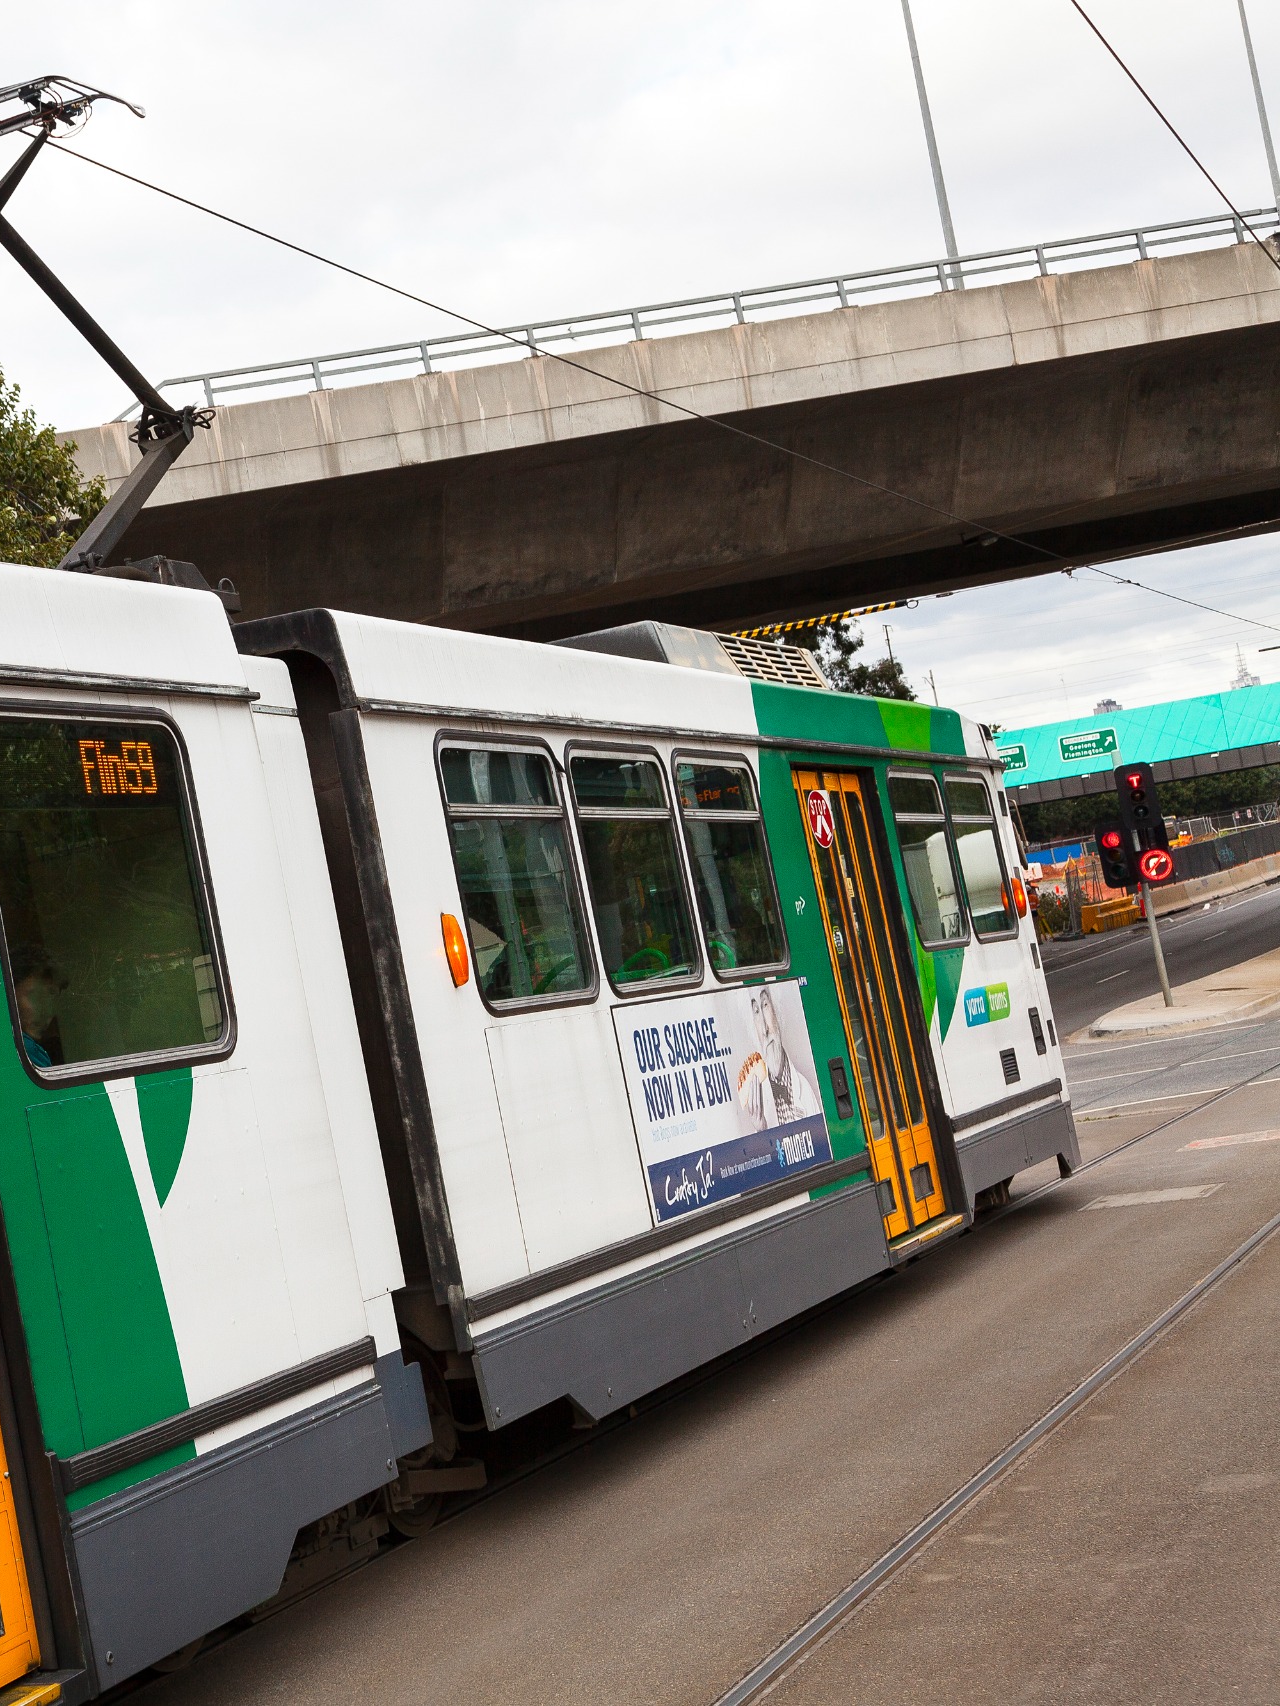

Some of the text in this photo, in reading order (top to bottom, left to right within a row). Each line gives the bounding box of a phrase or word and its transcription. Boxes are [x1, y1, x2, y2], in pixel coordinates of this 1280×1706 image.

[1064, 748, 1104, 758] Flemington
[1069, 742, 1096, 751] Geelong
[809, 799, 827, 816] STOP
[966, 991, 1008, 1022] yarra trams
[633, 1017, 732, 1074] OUR SAUSAGE...
[642, 1061, 733, 1122] NOW IN A BUN
